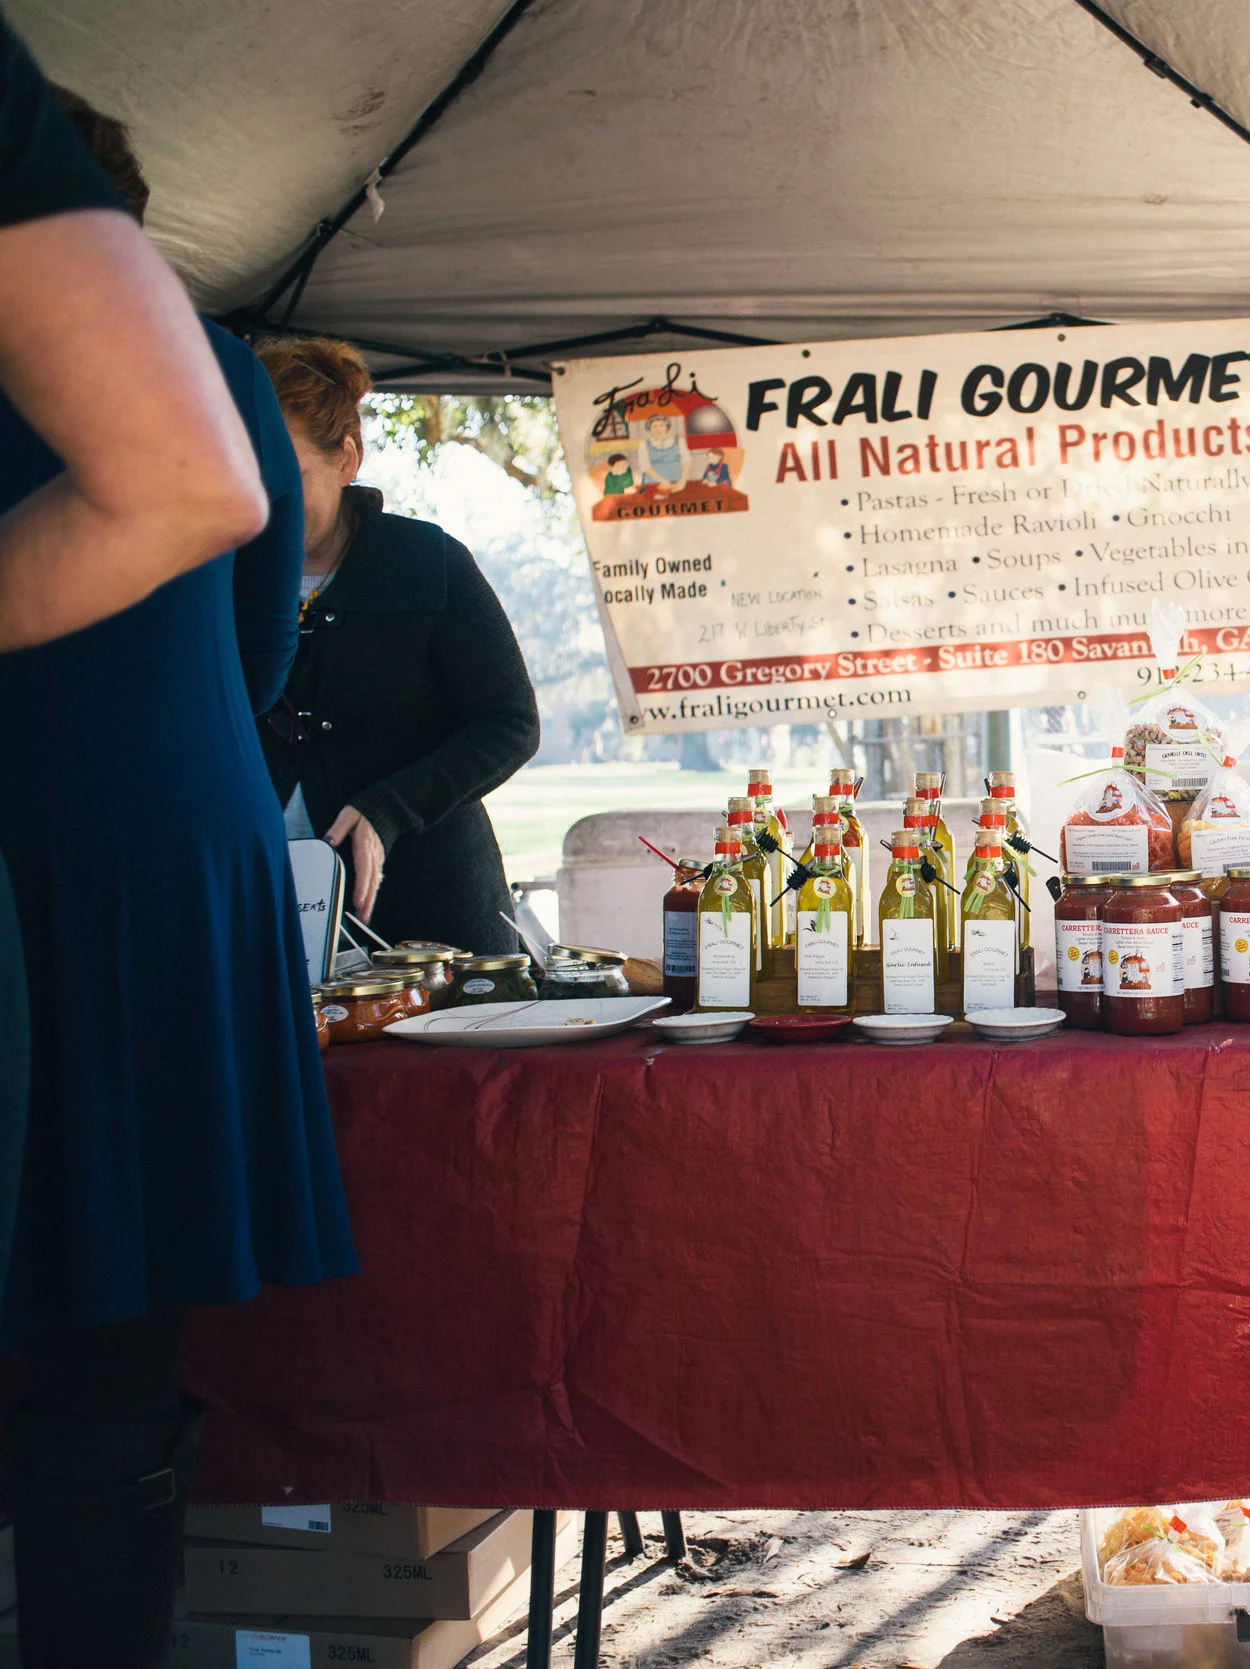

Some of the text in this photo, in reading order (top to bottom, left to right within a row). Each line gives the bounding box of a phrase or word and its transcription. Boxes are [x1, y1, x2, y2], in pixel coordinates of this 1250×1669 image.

[746, 368, 937, 431] FRALI
[776, 440, 837, 483] All
[859, 426, 1036, 478] Natural
[856, 491, 928, 512] Pastas
[952, 484, 1016, 506] Fresh
[1026, 486, 1052, 500] or
[616, 499, 724, 520] GOURMET
[859, 506, 1232, 546] Homemade Ravioli Gnocchi
[655, 554, 713, 575] Owned
[862, 557, 959, 579] Lasagna
[986, 548, 1062, 571] Soups
[1089, 537, 1217, 564] Vegetables
[1227, 533, 1249, 555] in
[604, 580, 707, 605] ocally Made
[962, 583, 1044, 605] Sauces
[1073, 570, 1164, 598] Infused
[1173, 566, 1238, 591] Olive
[731, 588, 823, 607] NEW LOCATION
[698, 623, 724, 644] 217
[867, 624, 968, 643] Desserts
[975, 612, 1021, 635] and
[1031, 608, 1098, 633] much
[647, 665, 713, 690] 2700
[719, 658, 831, 684] Gregory
[837, 652, 917, 676] Street
[938, 643, 1009, 669] Suite
[1018, 640, 1064, 664] 180
[1071, 628, 1208, 661] Savanh,
[643, 686, 911, 722] w.fraligourmet.com
[1103, 927, 1169, 935] CARRETTERA SAUCE
[1181, 921, 1199, 929] AUCE
[719, 938, 745, 950] GOURMET
[819, 938, 840, 948] GOURMET
[903, 946, 926, 955] GOURMET
[984, 946, 1009, 957] GOURMET
[907, 960, 931, 968] Infused
[219, 1560, 433, 1580] 12 325ML
[328, 1645, 376, 1663] 325ML
